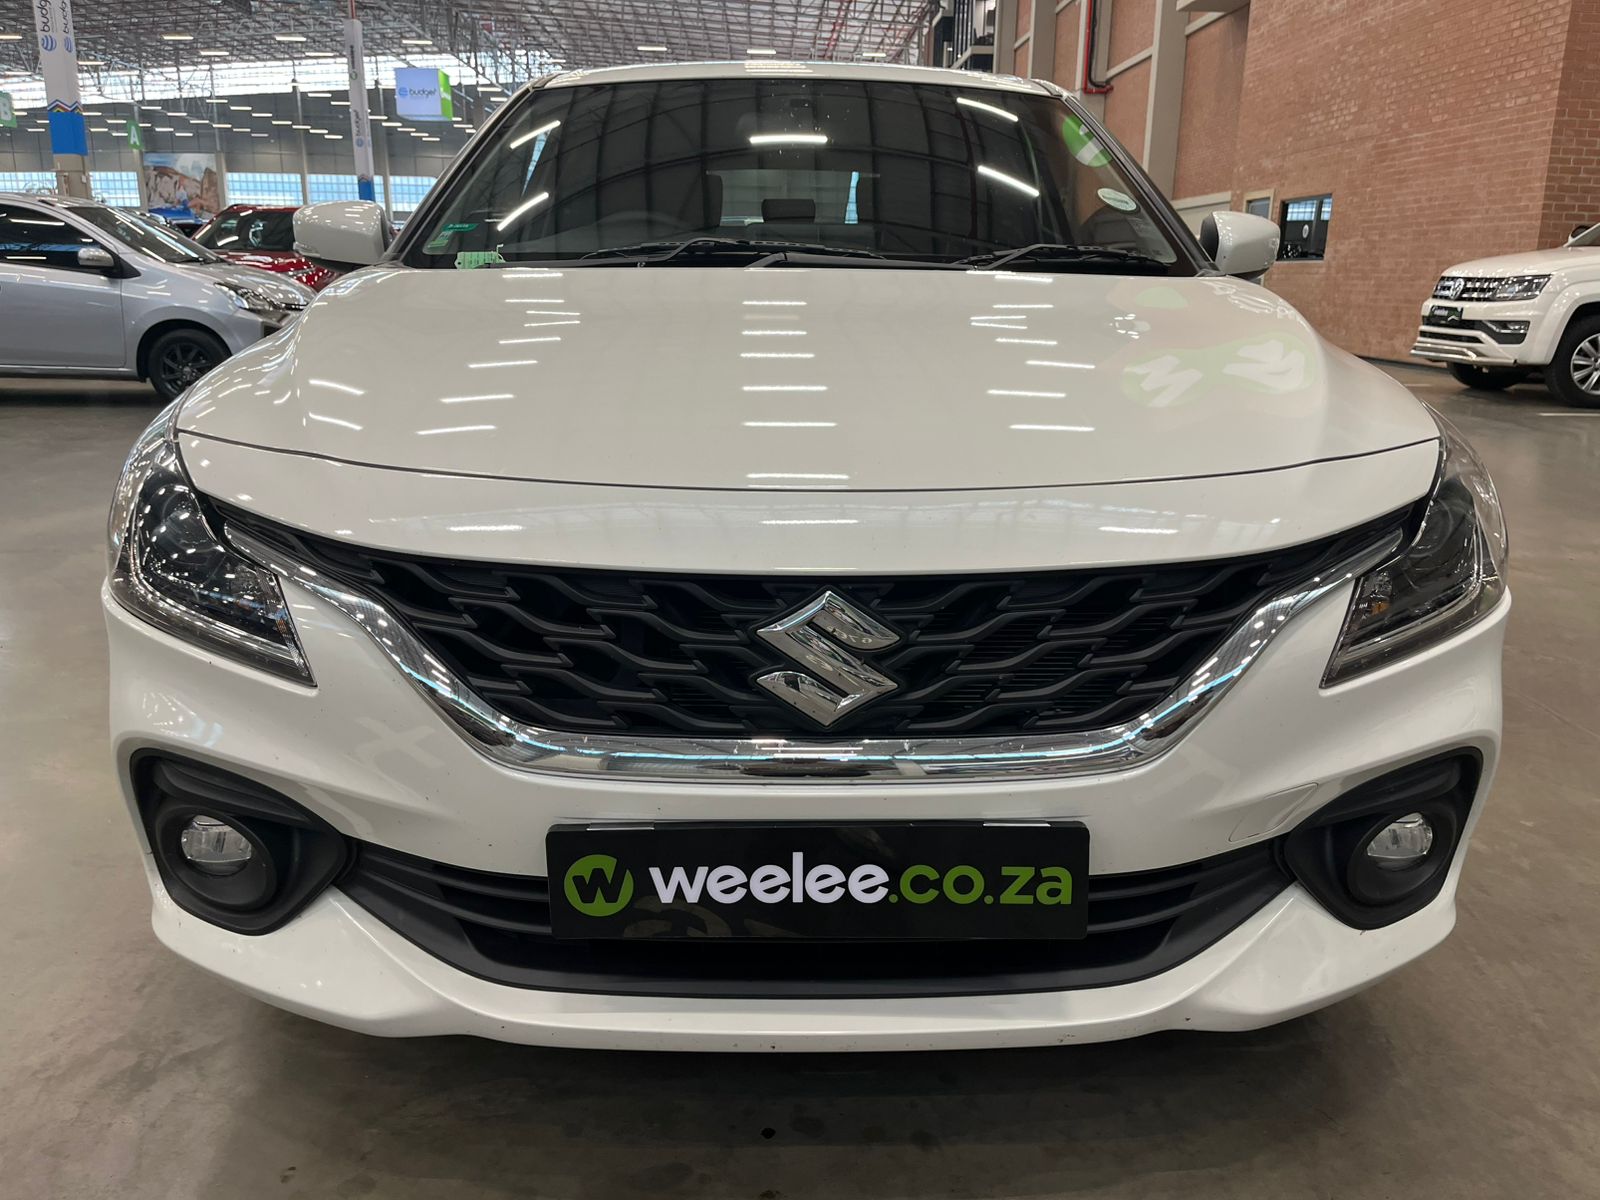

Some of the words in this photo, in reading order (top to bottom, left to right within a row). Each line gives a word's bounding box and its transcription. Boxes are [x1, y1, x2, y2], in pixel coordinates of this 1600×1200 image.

[409, 88, 437, 99] budget
[130, 125, 140, 146] A
[648, 851, 1074, 905] weelee.co.za
